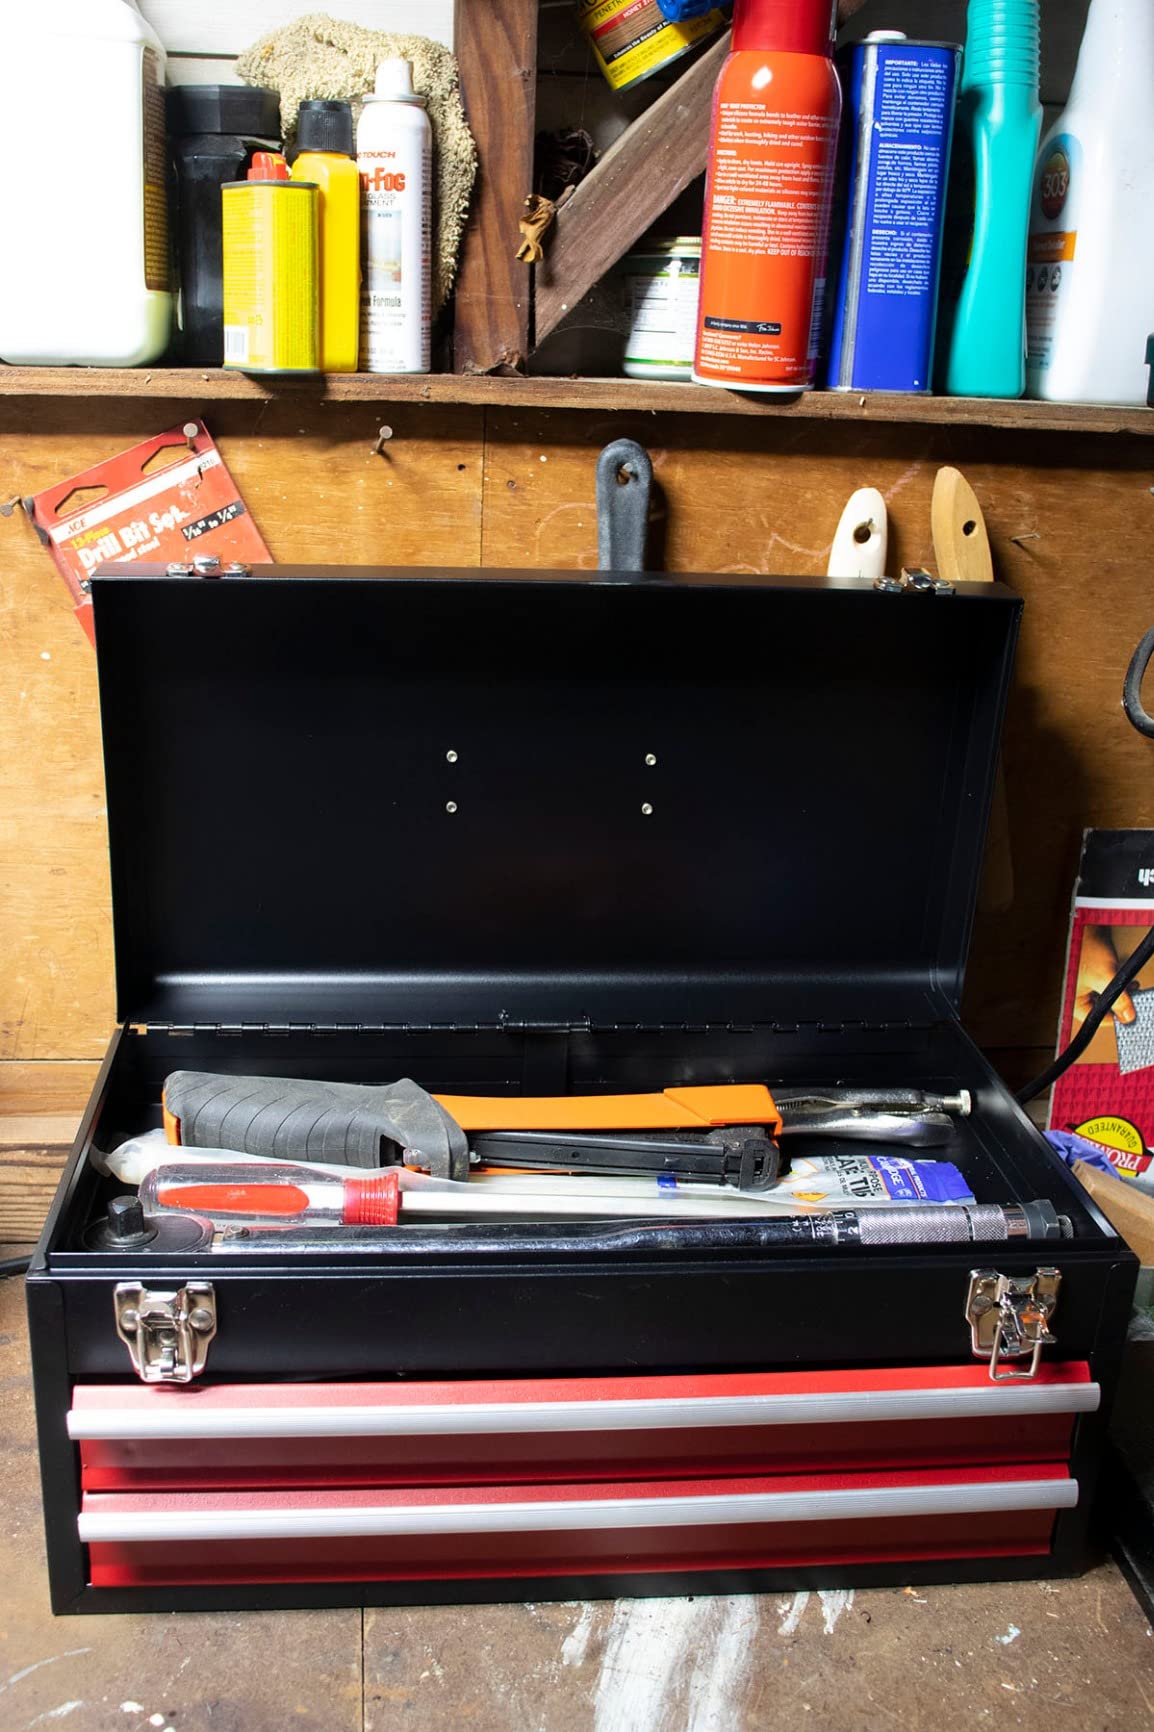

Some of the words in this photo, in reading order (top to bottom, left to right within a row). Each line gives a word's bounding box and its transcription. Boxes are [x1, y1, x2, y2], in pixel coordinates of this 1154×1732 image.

[1043, 172, 1067, 198] 303
[68, 520, 87, 535] ACE
[77, 531, 122, 568] Drill
[119, 520, 150, 549] Bit
[1088, 1122, 1137, 1148] GUARANTEED
